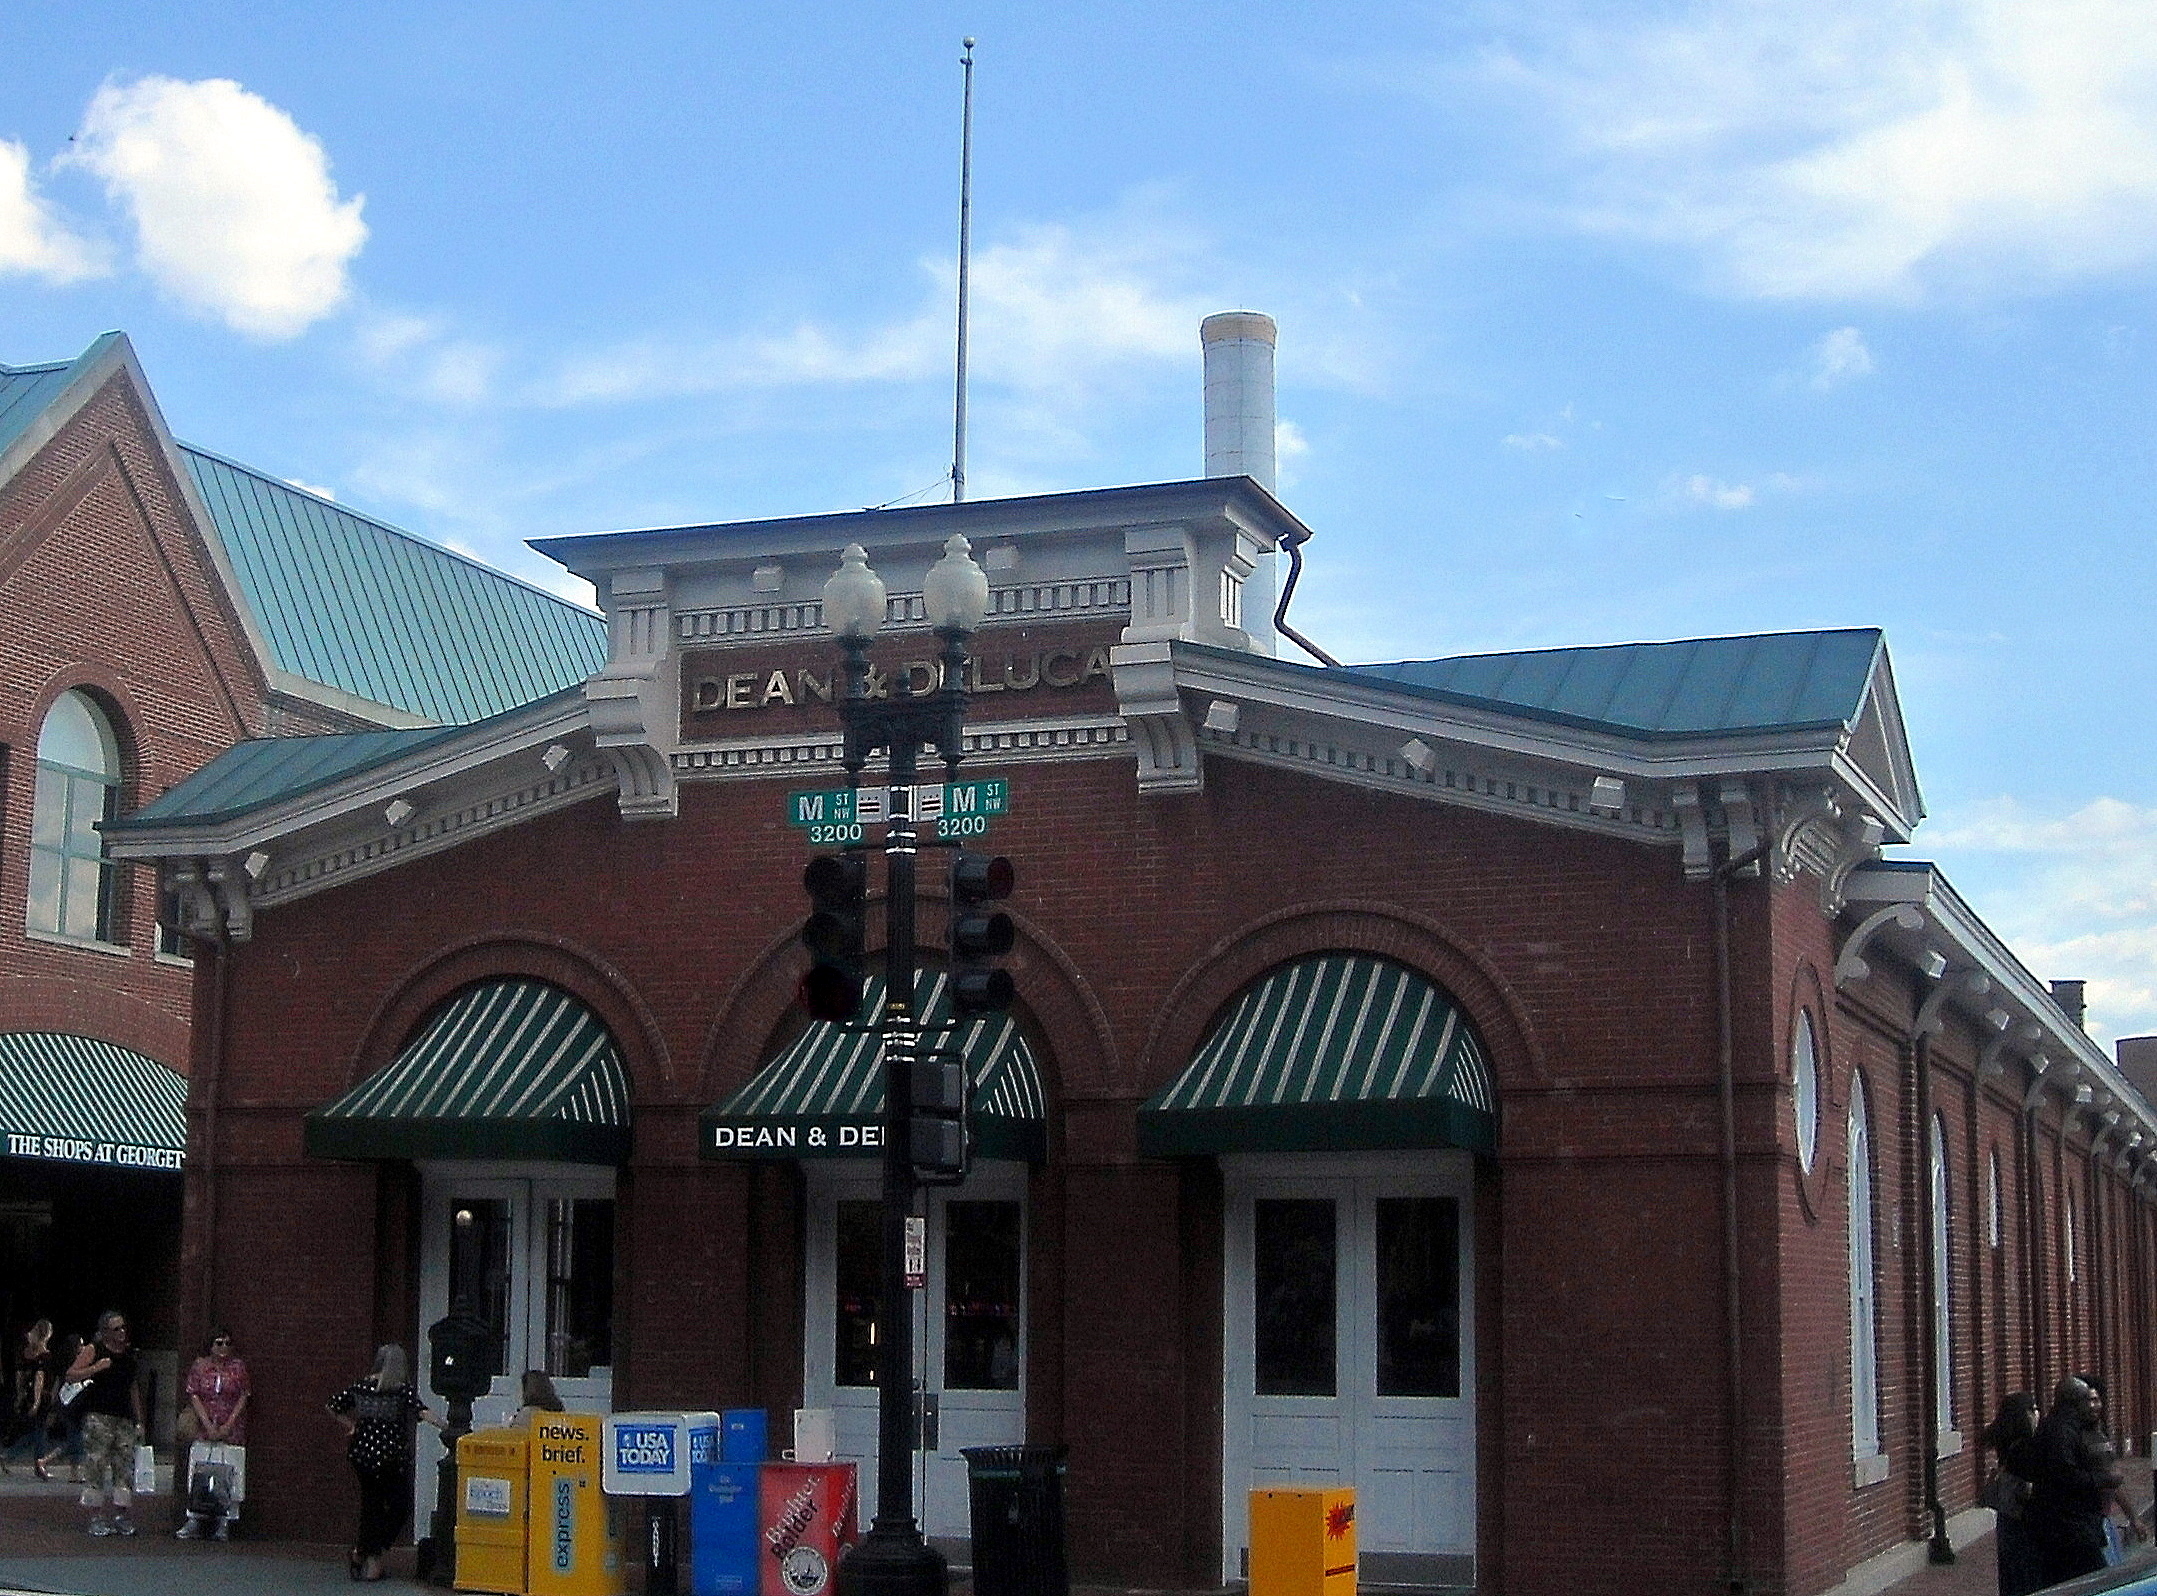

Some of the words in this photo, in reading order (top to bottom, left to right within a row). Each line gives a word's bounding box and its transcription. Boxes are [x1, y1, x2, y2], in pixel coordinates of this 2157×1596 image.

[692, 667, 834, 712] DEAN
[861, 662, 888, 699] &
[799, 795, 824, 821] M
[835, 793, 849, 806] ST
[952, 786, 976, 812] M
[986, 783, 1000, 796] ST
[985, 797, 1001, 811] NW
[834, 807, 850, 820] NW
[810, 823, 862, 843] 3200
[938, 816, 986, 837] 3200
[715, 1126, 796, 1147] DEAN
[807, 1126, 827, 1147] &
[8, 1134, 41, 1156] THE
[44, 1137, 93, 1161] SHOPS
[94, 1143, 115, 1163] AT
[116, 1144, 186, 1170] GEORGET
[539, 1425, 590, 1441] news.
[636, 1432, 669, 1449] USA
[541, 1444, 586, 1463] brief.
[619, 1448, 671, 1465] TODAY
[557, 1482, 572, 1567] express
